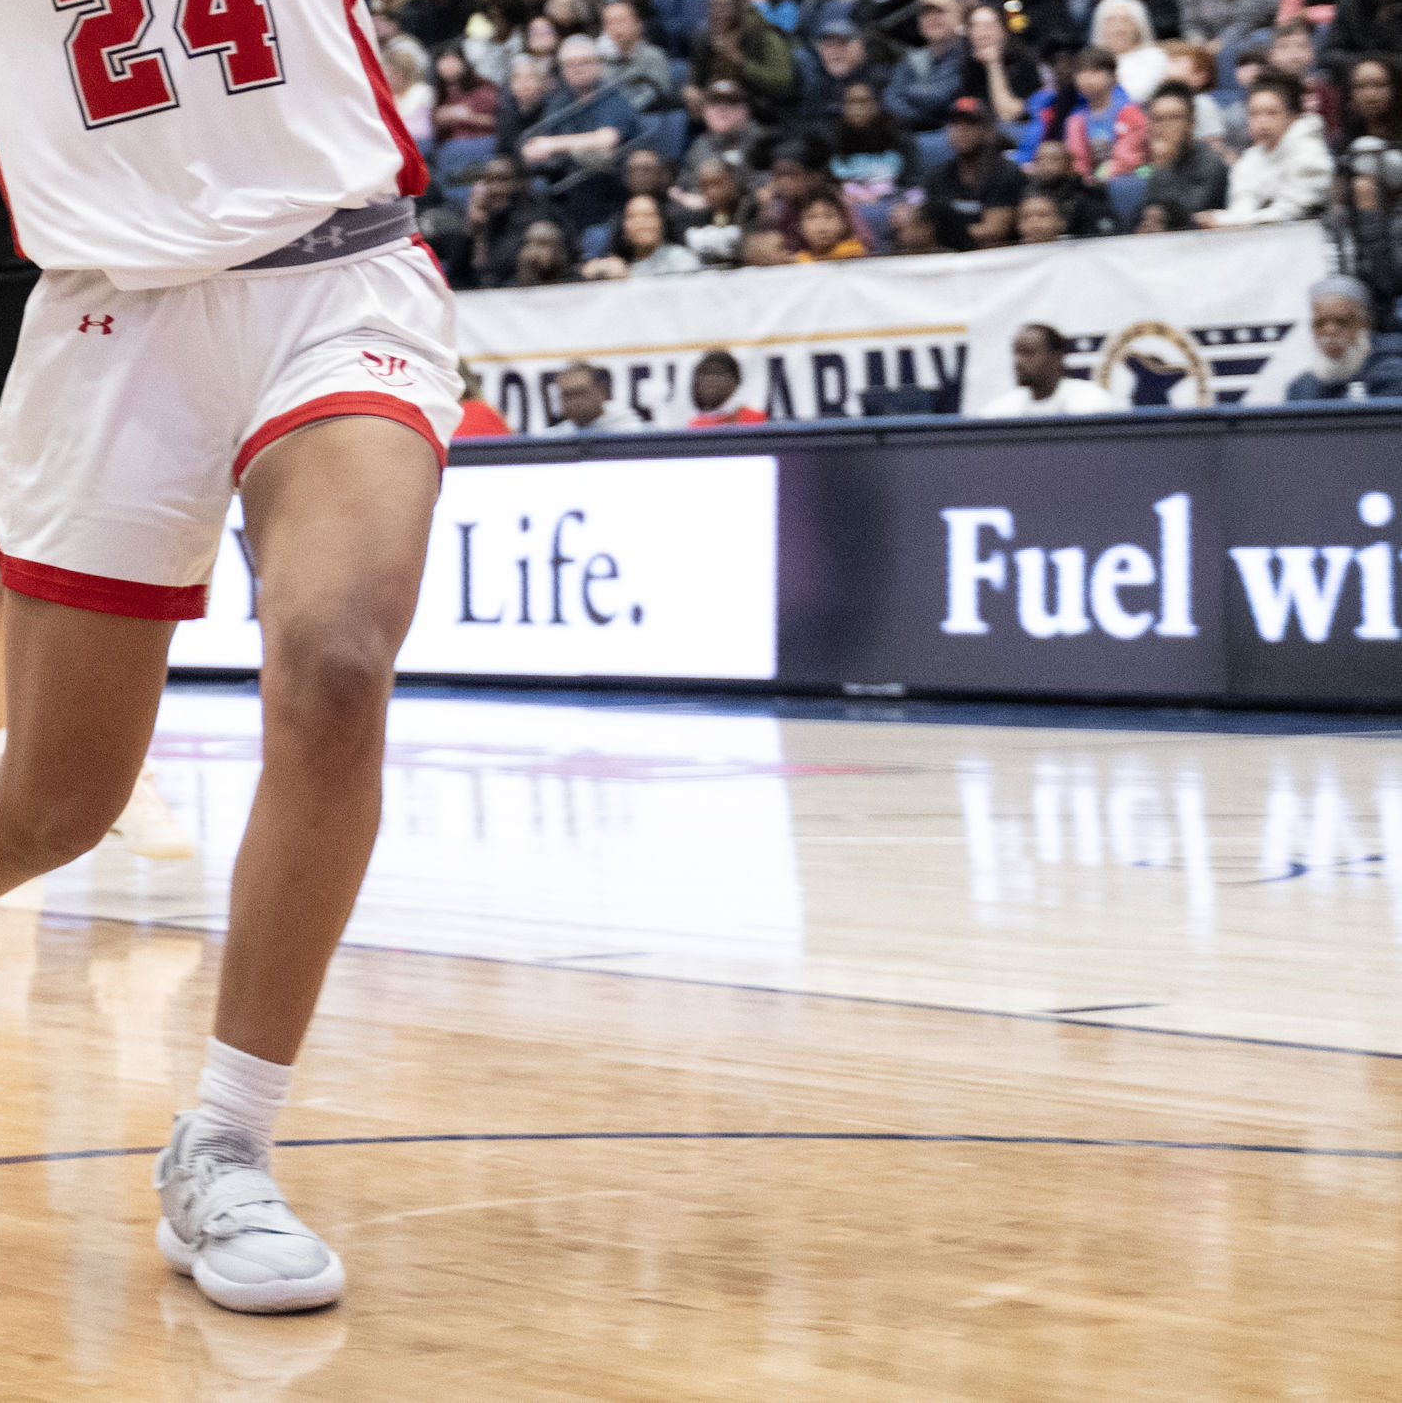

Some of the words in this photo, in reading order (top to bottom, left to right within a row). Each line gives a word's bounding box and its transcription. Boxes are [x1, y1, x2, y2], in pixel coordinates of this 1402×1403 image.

[455, 508, 645, 627] Life.
[939, 491, 1200, 641] Fuel
[1227, 490, 1402, 644] wi
